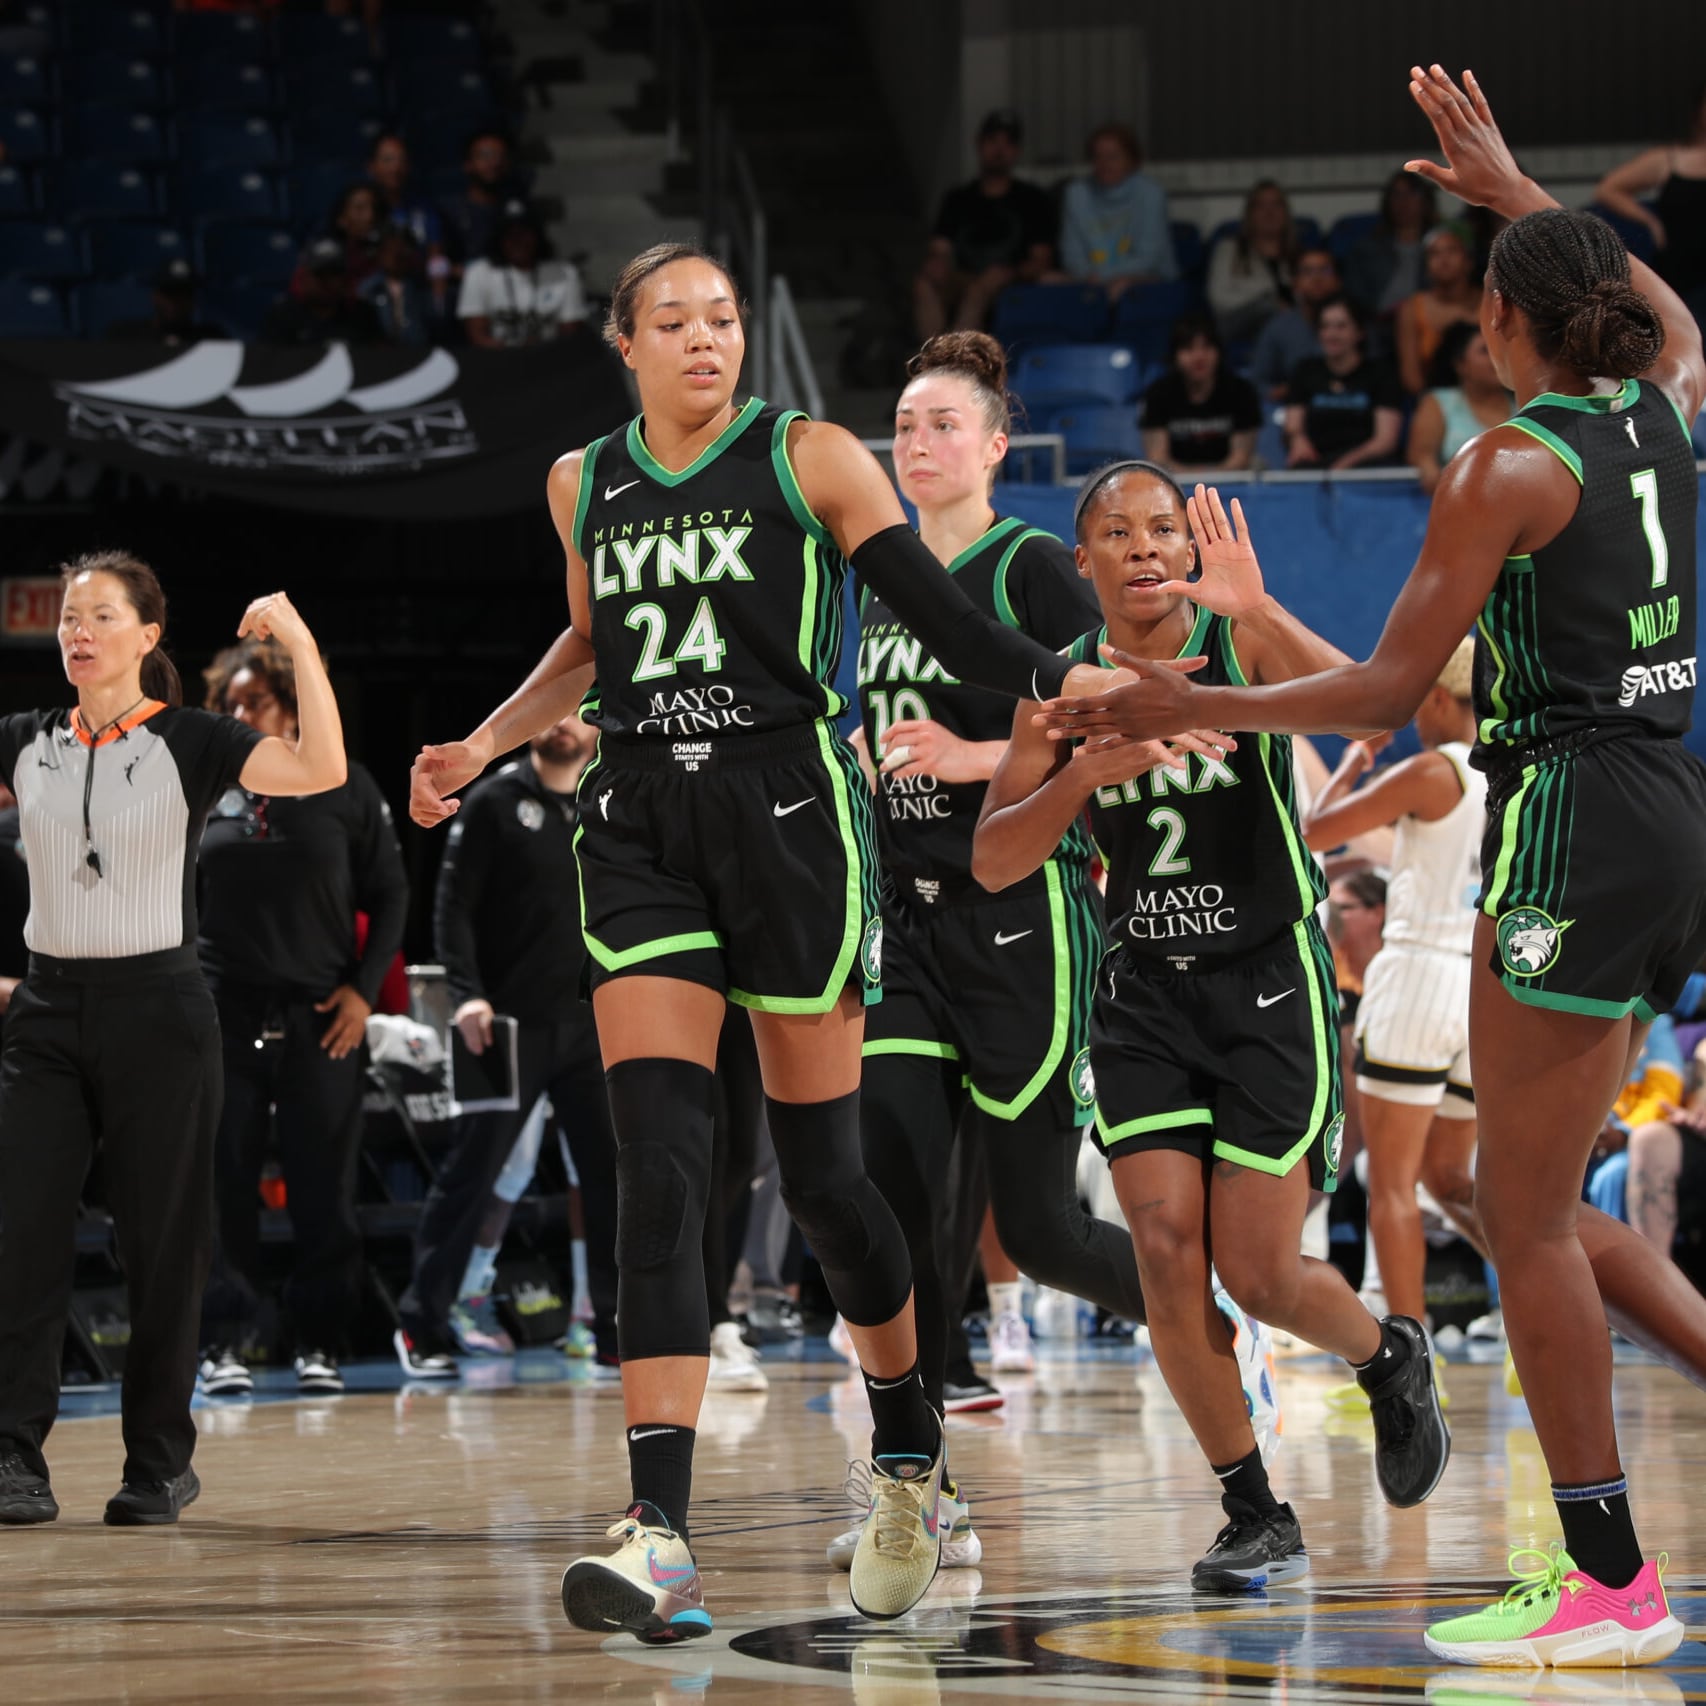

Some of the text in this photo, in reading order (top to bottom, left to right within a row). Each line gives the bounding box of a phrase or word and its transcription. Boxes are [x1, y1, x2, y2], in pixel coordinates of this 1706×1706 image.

[594, 509, 754, 543] MINNESOTA
[1629, 468, 1668, 588] 1
[594, 527, 755, 600] LYNX
[624, 596, 727, 683] 24
[1628, 595, 1680, 650] MILLER
[1640, 657, 1697, 697] AT&T
[649, 685, 734, 717] MAYO
[672, 742, 713, 754] CHANGE
[685, 761, 699, 771] US
[1146, 806, 1192, 876] 2
[1134, 884, 1224, 914] MAYO
[1128, 907, 1238, 939] CLINIC
